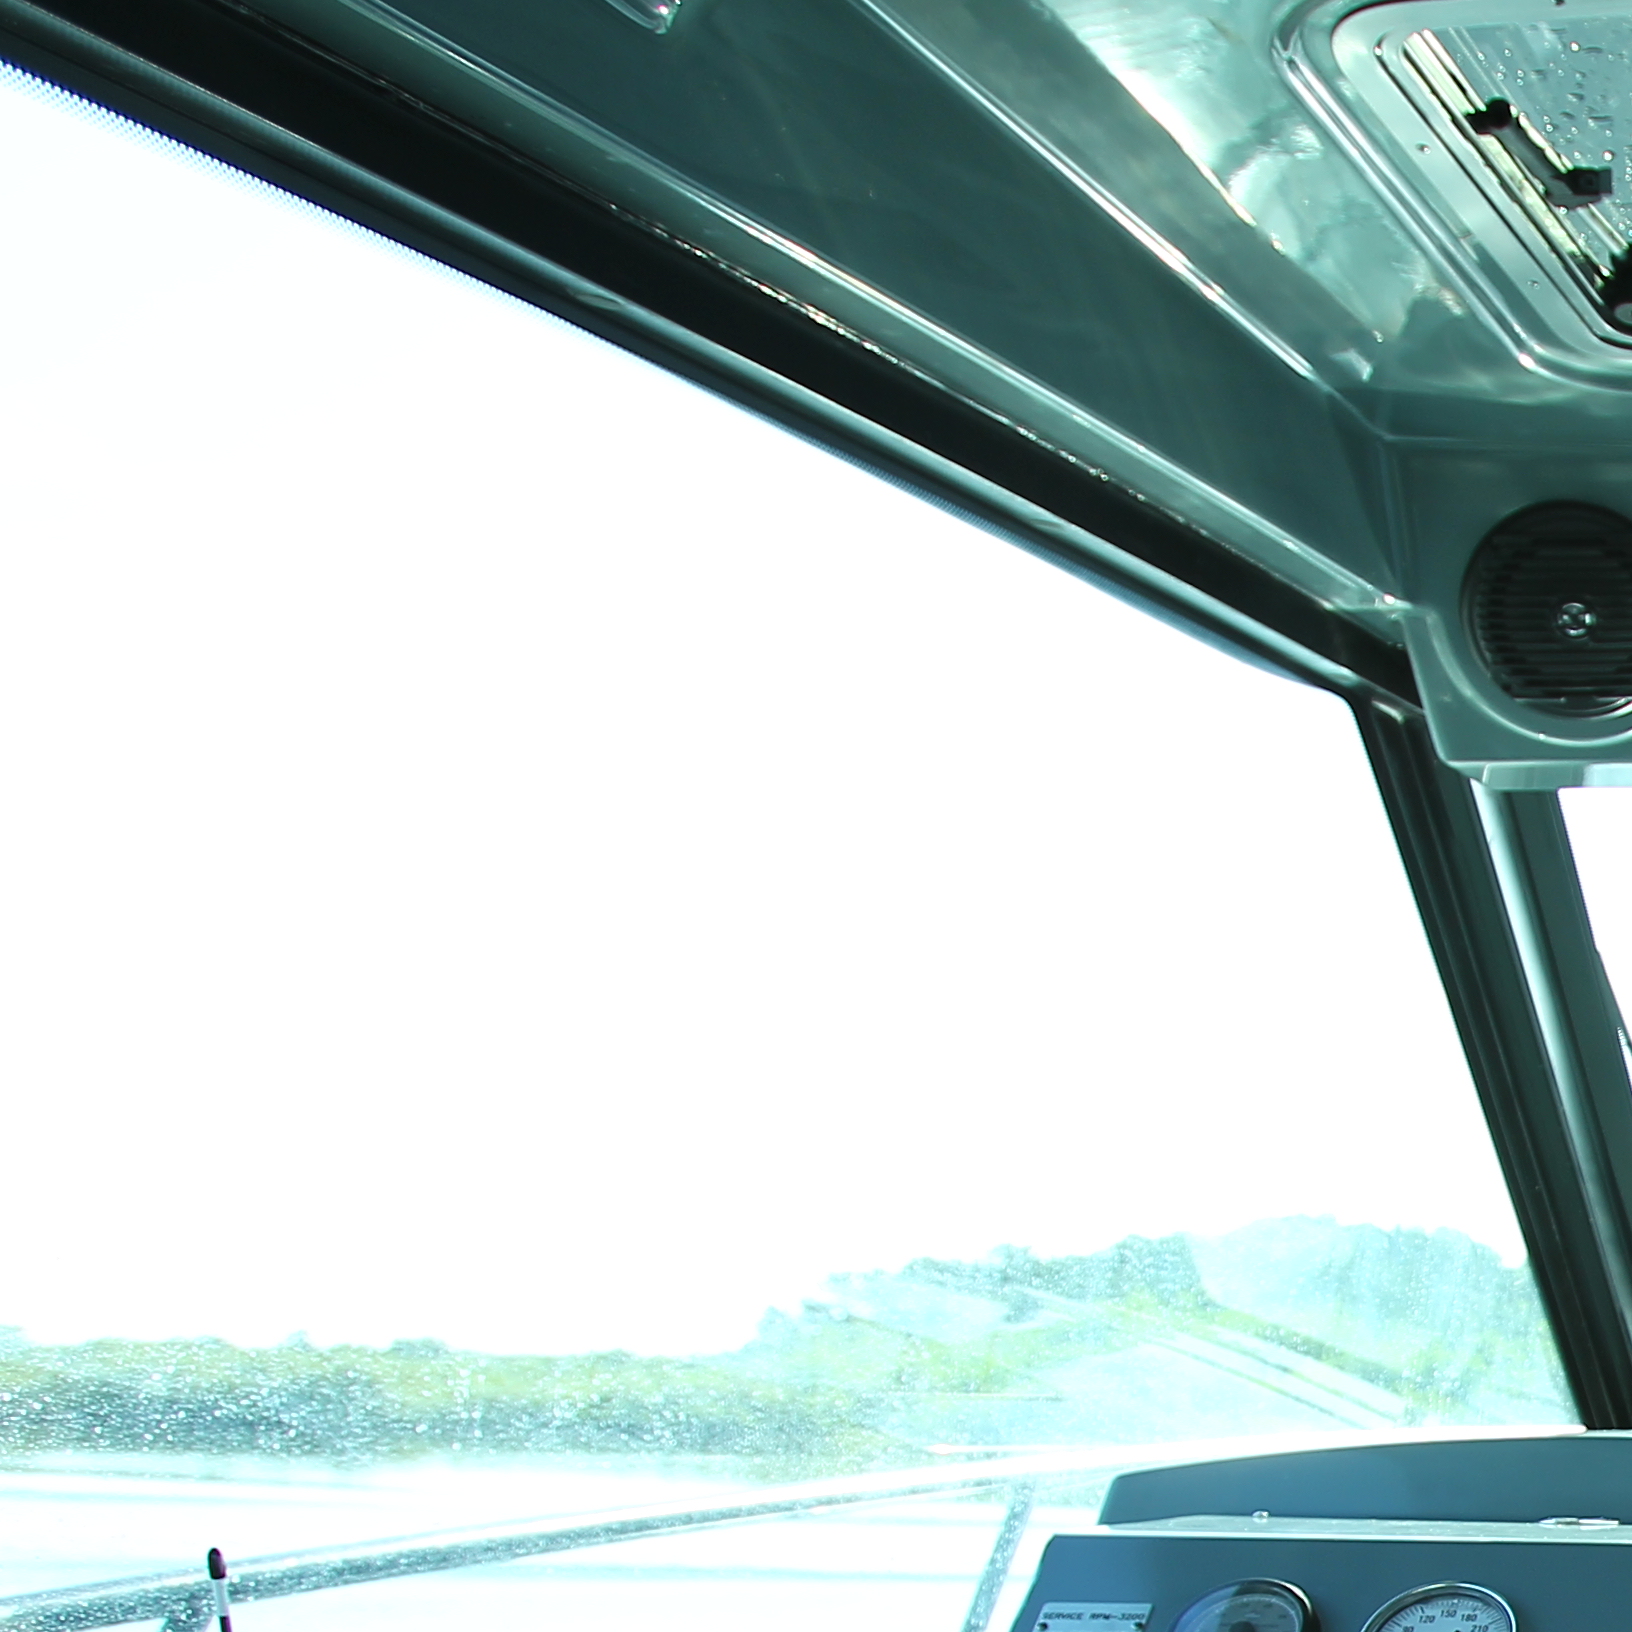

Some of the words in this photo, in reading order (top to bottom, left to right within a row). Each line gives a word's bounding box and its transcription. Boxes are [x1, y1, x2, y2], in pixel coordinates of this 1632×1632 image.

[1041, 1612, 1084, 1620] SERVICE
[1440, 1610, 1456, 1618] 150
[1460, 1614, 1478, 1622] 180
[1418, 1615, 1435, 1624] 120
